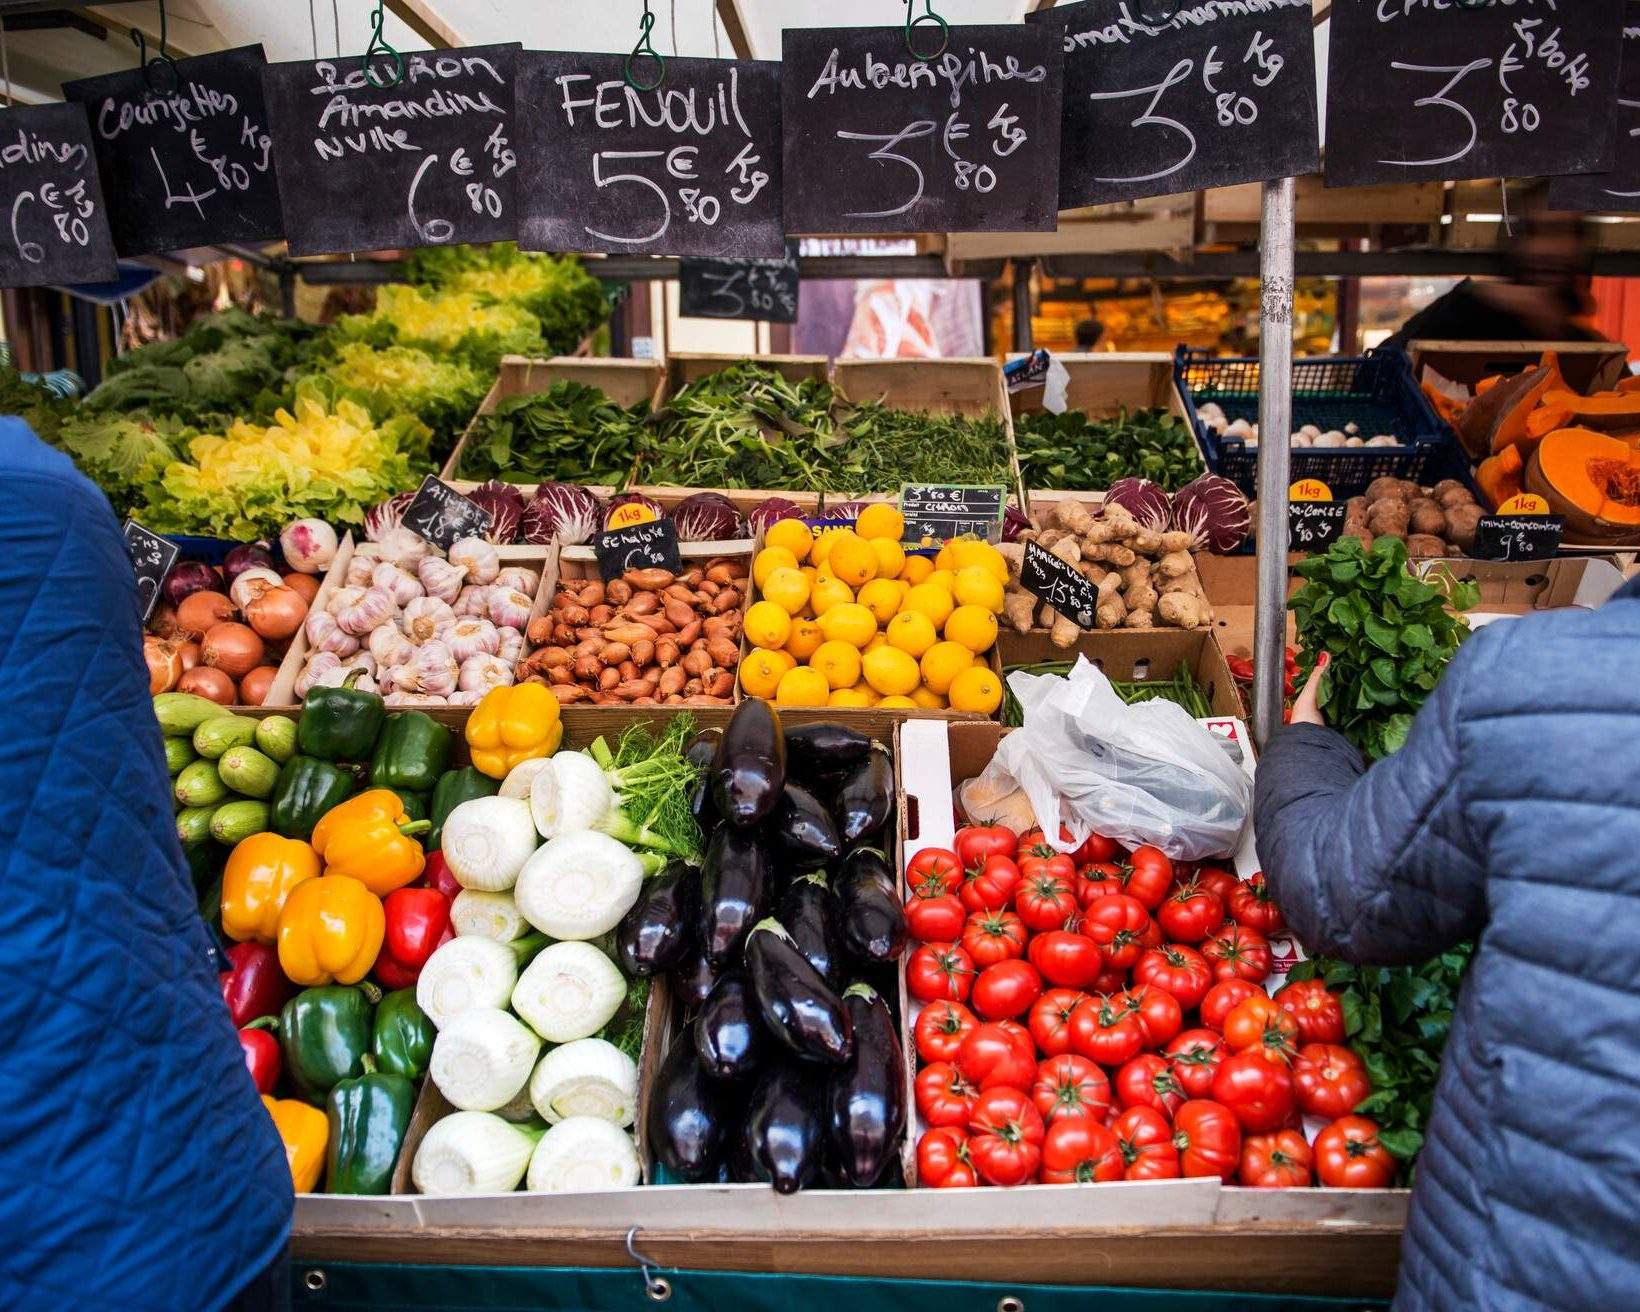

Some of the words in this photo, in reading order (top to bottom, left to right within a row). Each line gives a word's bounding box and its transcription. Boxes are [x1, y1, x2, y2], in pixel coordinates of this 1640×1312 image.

[1090, 59, 1197, 182] 3
[1215, 91, 1258, 127] 80
[1376, 57, 1493, 166] 3
[1500, 97, 1540, 133] 80
[151, 146, 217, 221] 4
[210, 155, 250, 191] 80
[836, 120, 938, 218] 3
[954, 160, 997, 193] 80
[408, 154, 455, 243] 6
[466, 182, 503, 218] 80
[585, 151, 671, 243] 5
[666, 146, 700, 179] €
[679, 188, 721, 225] 80
[11, 190, 45, 263] 6
[53, 212, 89, 246] 80
[949, 490, 962, 502] €
[1298, 482, 1321, 498] 1kg
[1514, 498, 1537, 511] 1kg
[617, 507, 642, 523] 1kg
